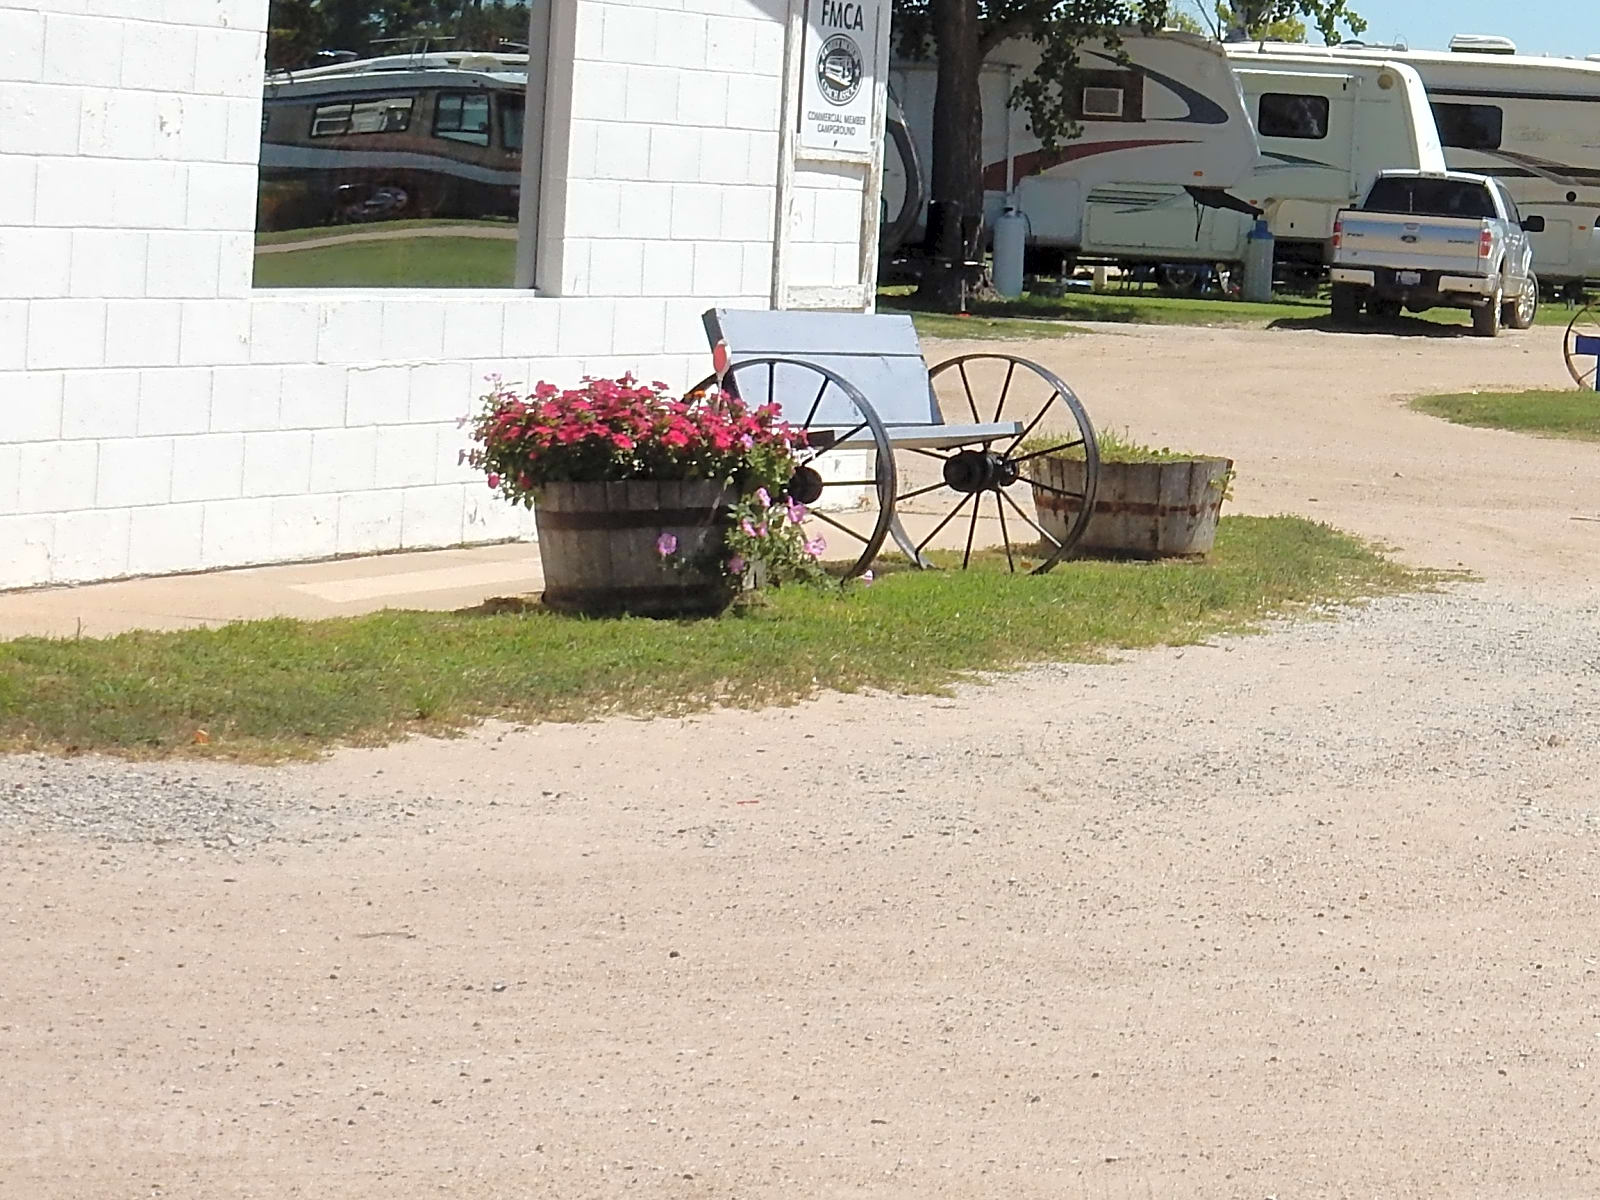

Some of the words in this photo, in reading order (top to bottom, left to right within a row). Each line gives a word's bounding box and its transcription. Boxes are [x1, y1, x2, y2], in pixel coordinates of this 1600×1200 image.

[821, 0, 864, 31] FMCA
[807, 111, 842, 124] COMMERCIAL
[844, 114, 866, 125] MEMBER
[817, 123, 856, 136] CAMPGROUND
